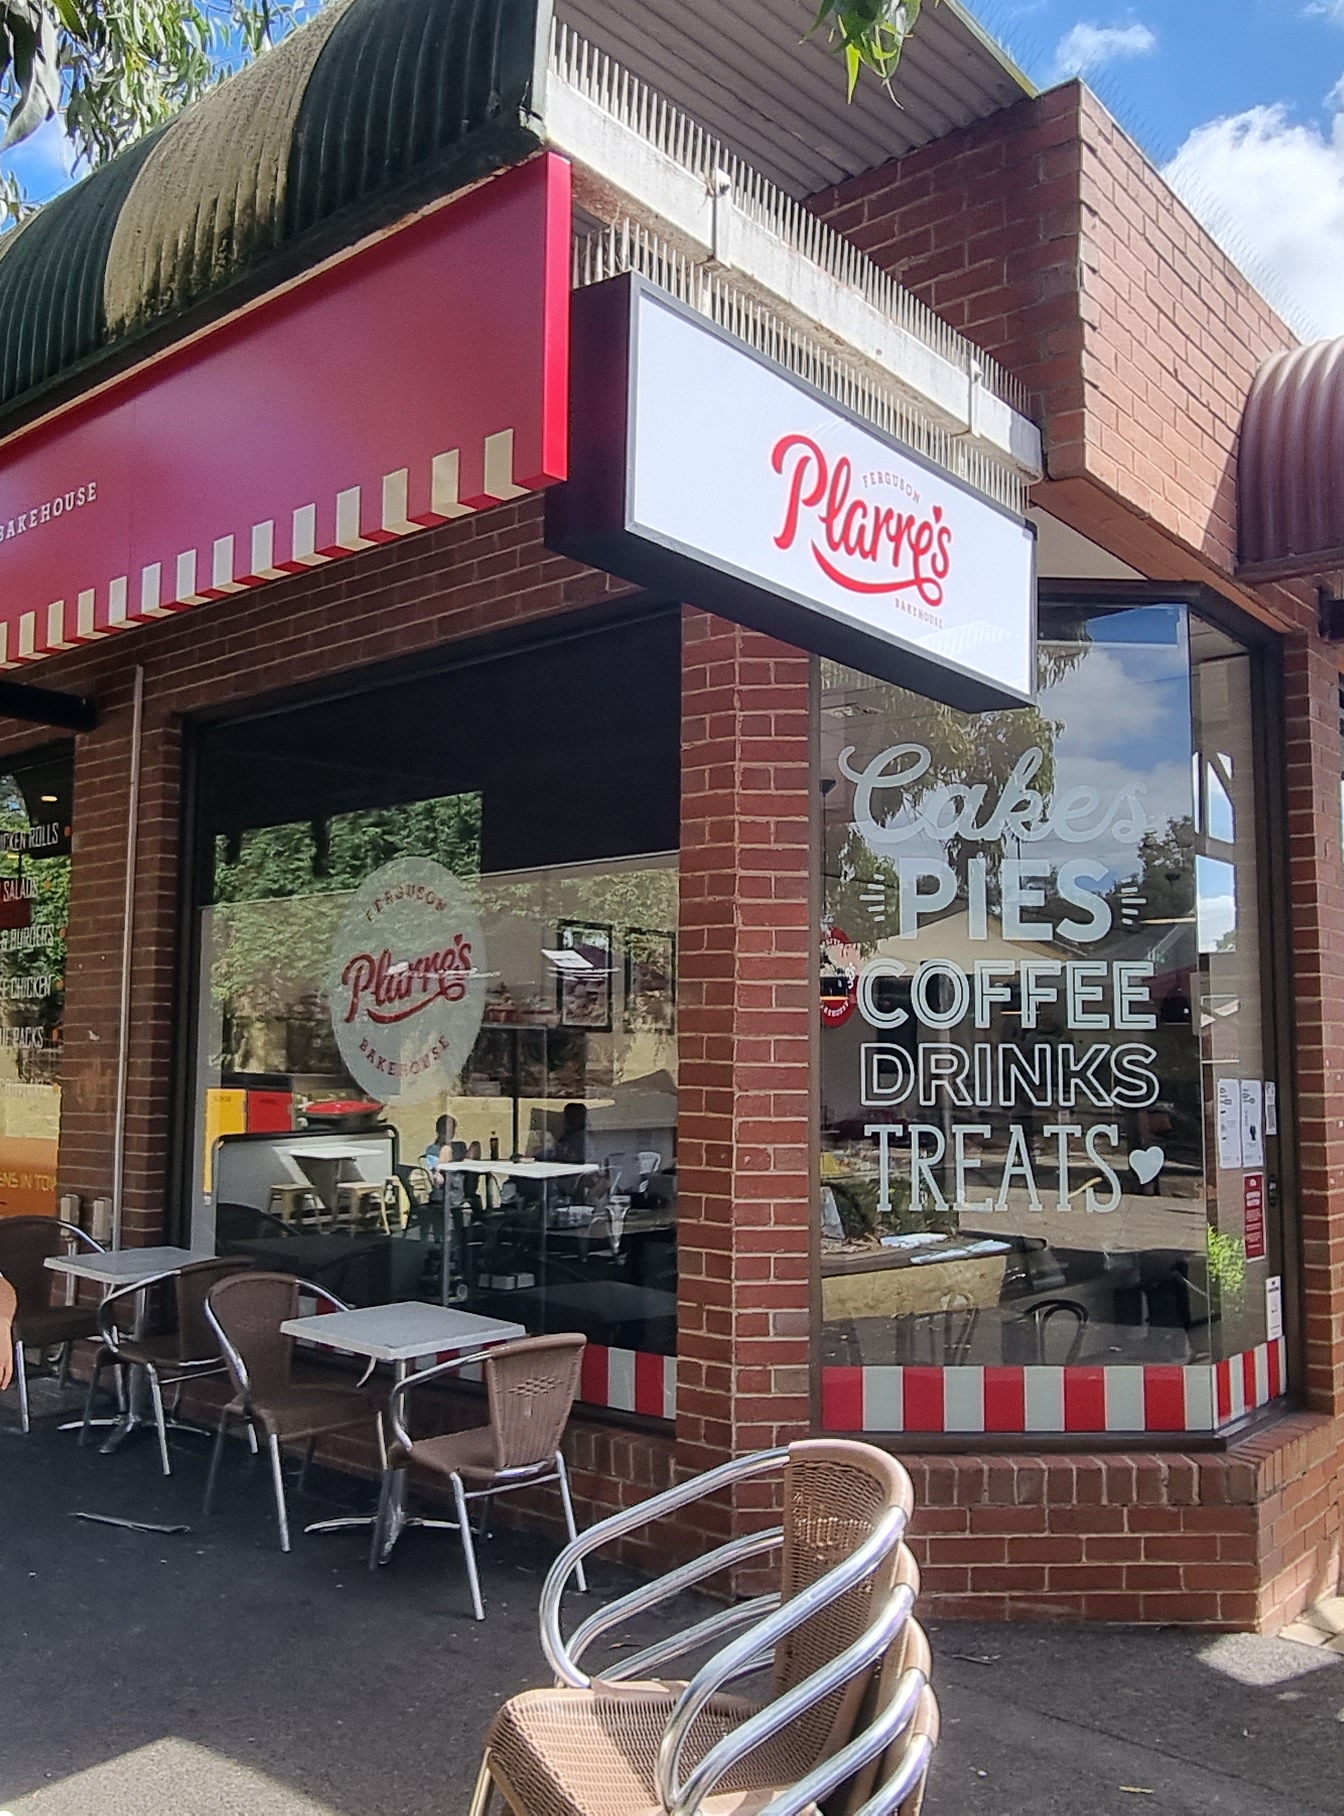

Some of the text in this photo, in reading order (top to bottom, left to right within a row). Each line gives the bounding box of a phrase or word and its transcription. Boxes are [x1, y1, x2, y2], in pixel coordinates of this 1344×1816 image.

[862, 471, 921, 505] FERGUSON
[771, 434, 952, 607] Plarre's
[894, 597, 944, 629] BAKEHOUSE
[838, 743, 1148, 844] Cakes
[29, 822, 59, 848] ROLLS
[4, 876, 38, 902] SALADS
[366, 883, 449, 922] FERGUSON
[899, 858, 1113, 942] PIES
[856, 958, 1157, 1030] COFFEE
[13, 1026, 44, 1050] PACKS
[359, 1035, 450, 1076] BAKEHOUSE
[860, 1043, 1160, 1108] DRINKS
[864, 1124, 1123, 1213] TREATS
